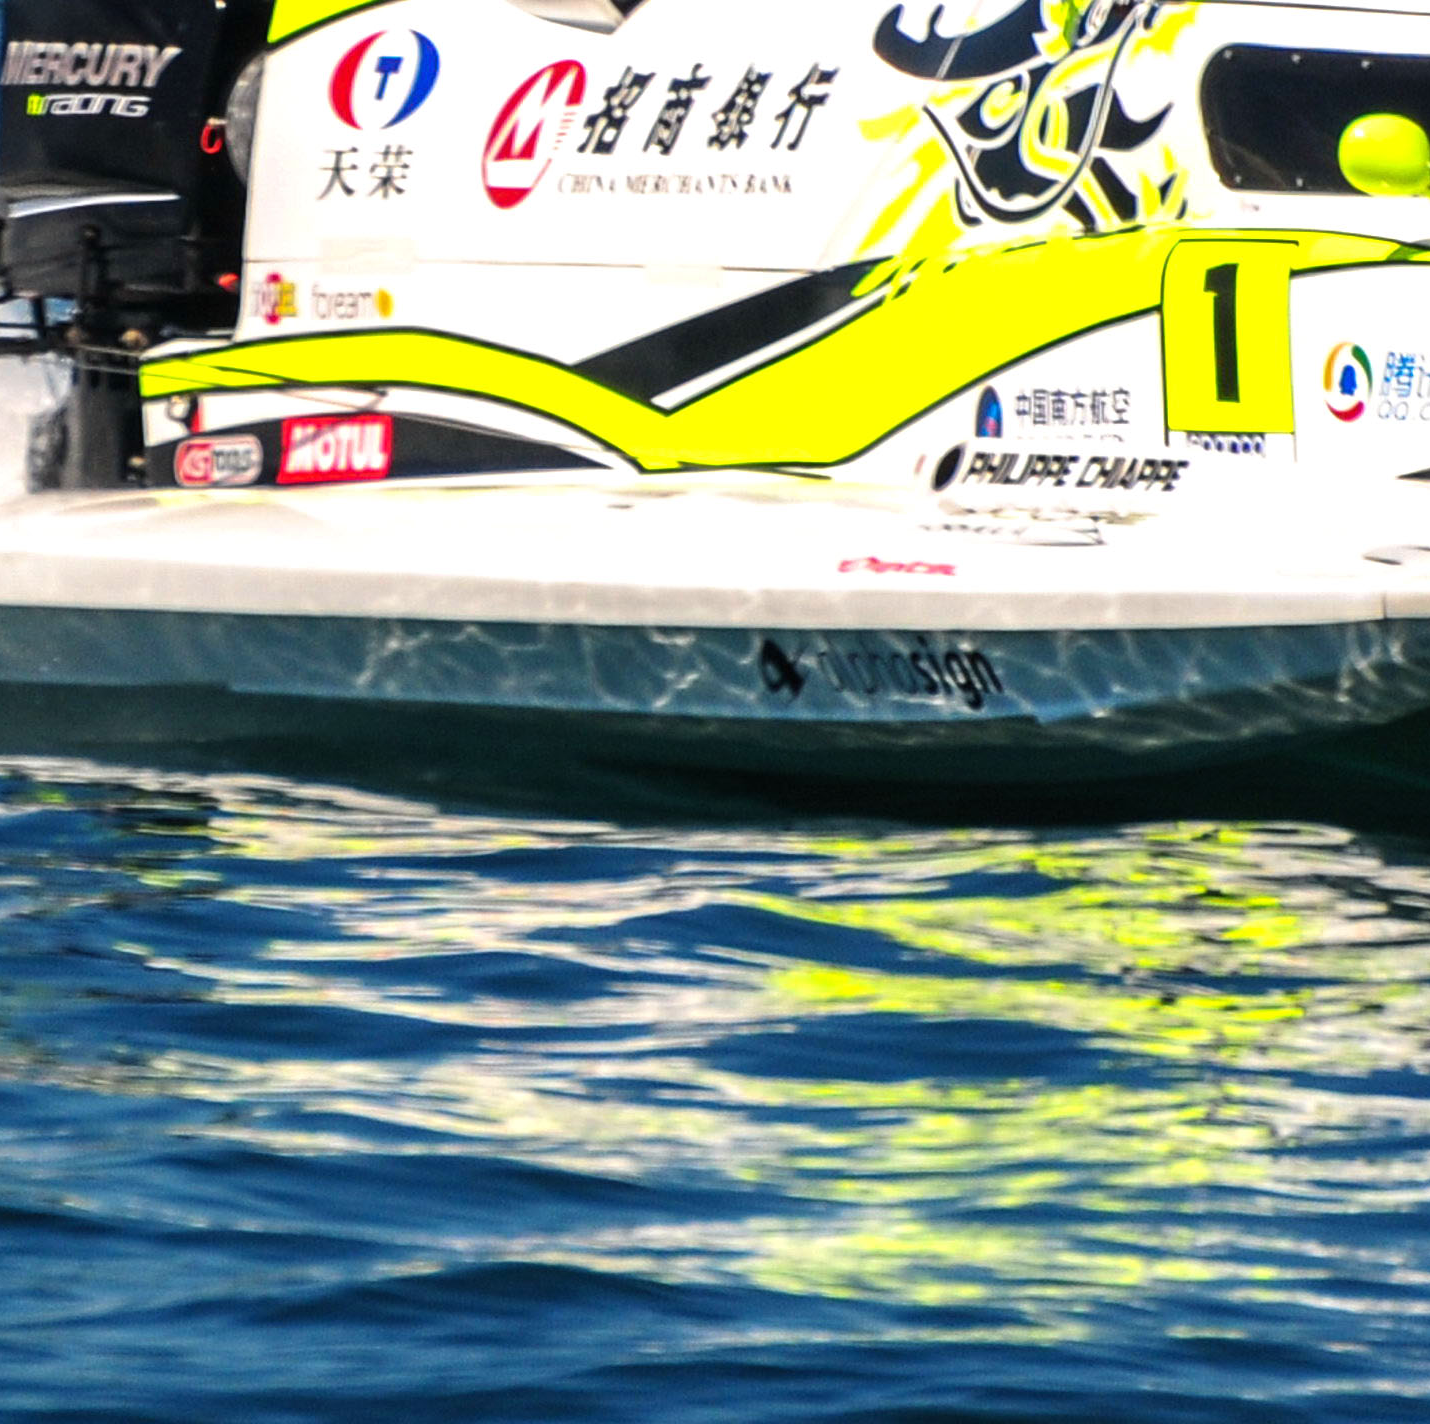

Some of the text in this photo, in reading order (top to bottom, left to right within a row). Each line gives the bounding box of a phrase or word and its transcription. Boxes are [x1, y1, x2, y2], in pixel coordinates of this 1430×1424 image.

[0, 40, 183, 87] MERCURY
[316, 144, 413, 201] 天荣
[557, 173, 793, 194] CHINA MERCHANTS BANK
[1203, 262, 1241, 403] 1
[1015, 387, 1131, 426] 中国南方航空
[284, 423, 386, 473] MOTUL
[962, 451, 1190, 492] PHILIPPE CHIAPPE
